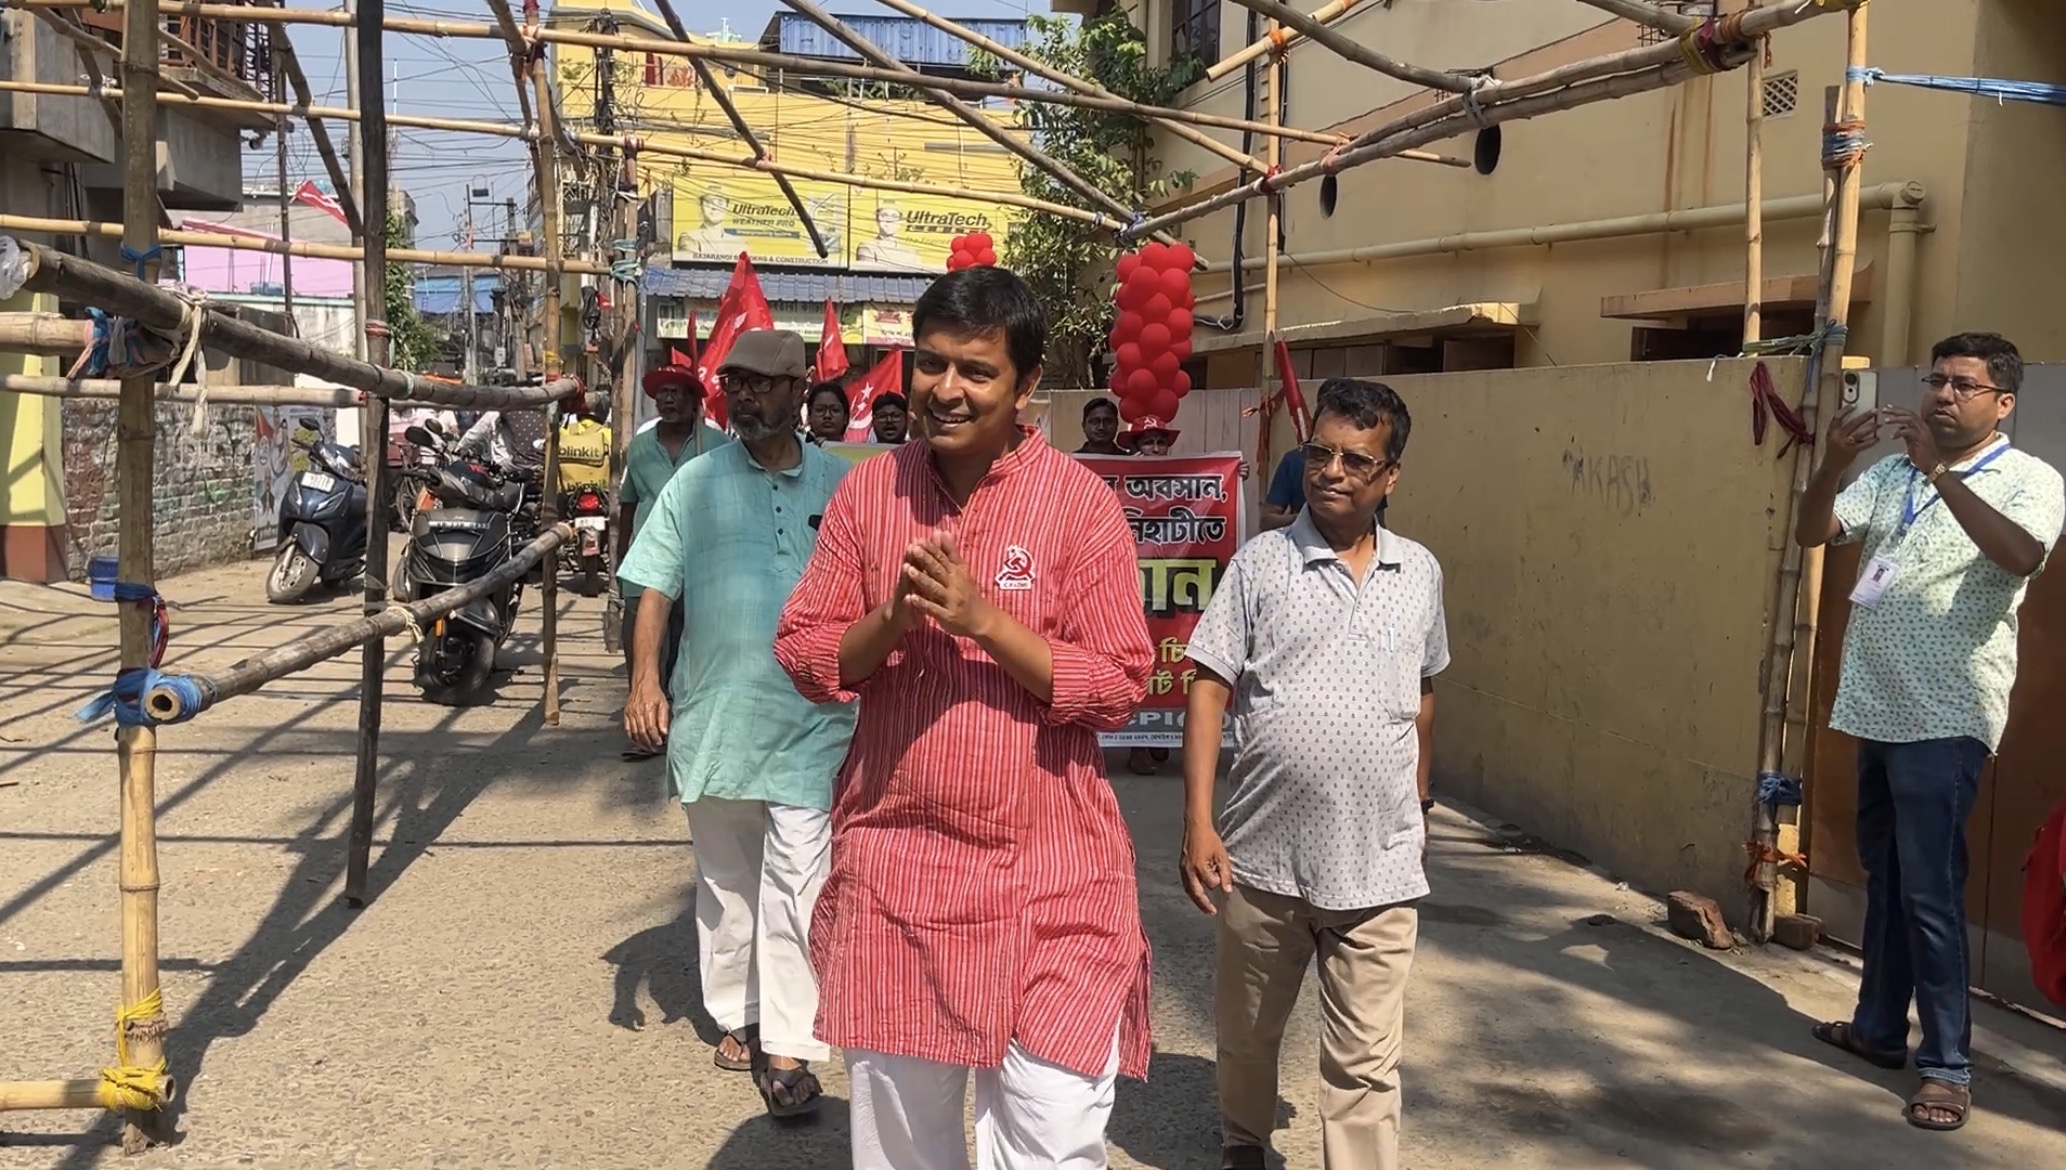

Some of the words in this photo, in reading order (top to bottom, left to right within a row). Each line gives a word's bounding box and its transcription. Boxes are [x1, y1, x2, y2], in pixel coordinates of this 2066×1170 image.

[732, 203, 795, 217] UltraTech
[906, 210, 987, 227] UltraTech
[559, 446, 600, 457] blinkit
[1123, 474, 1228, 503] অবসান,
[1122, 505, 1227, 546] নিহাটীতে
